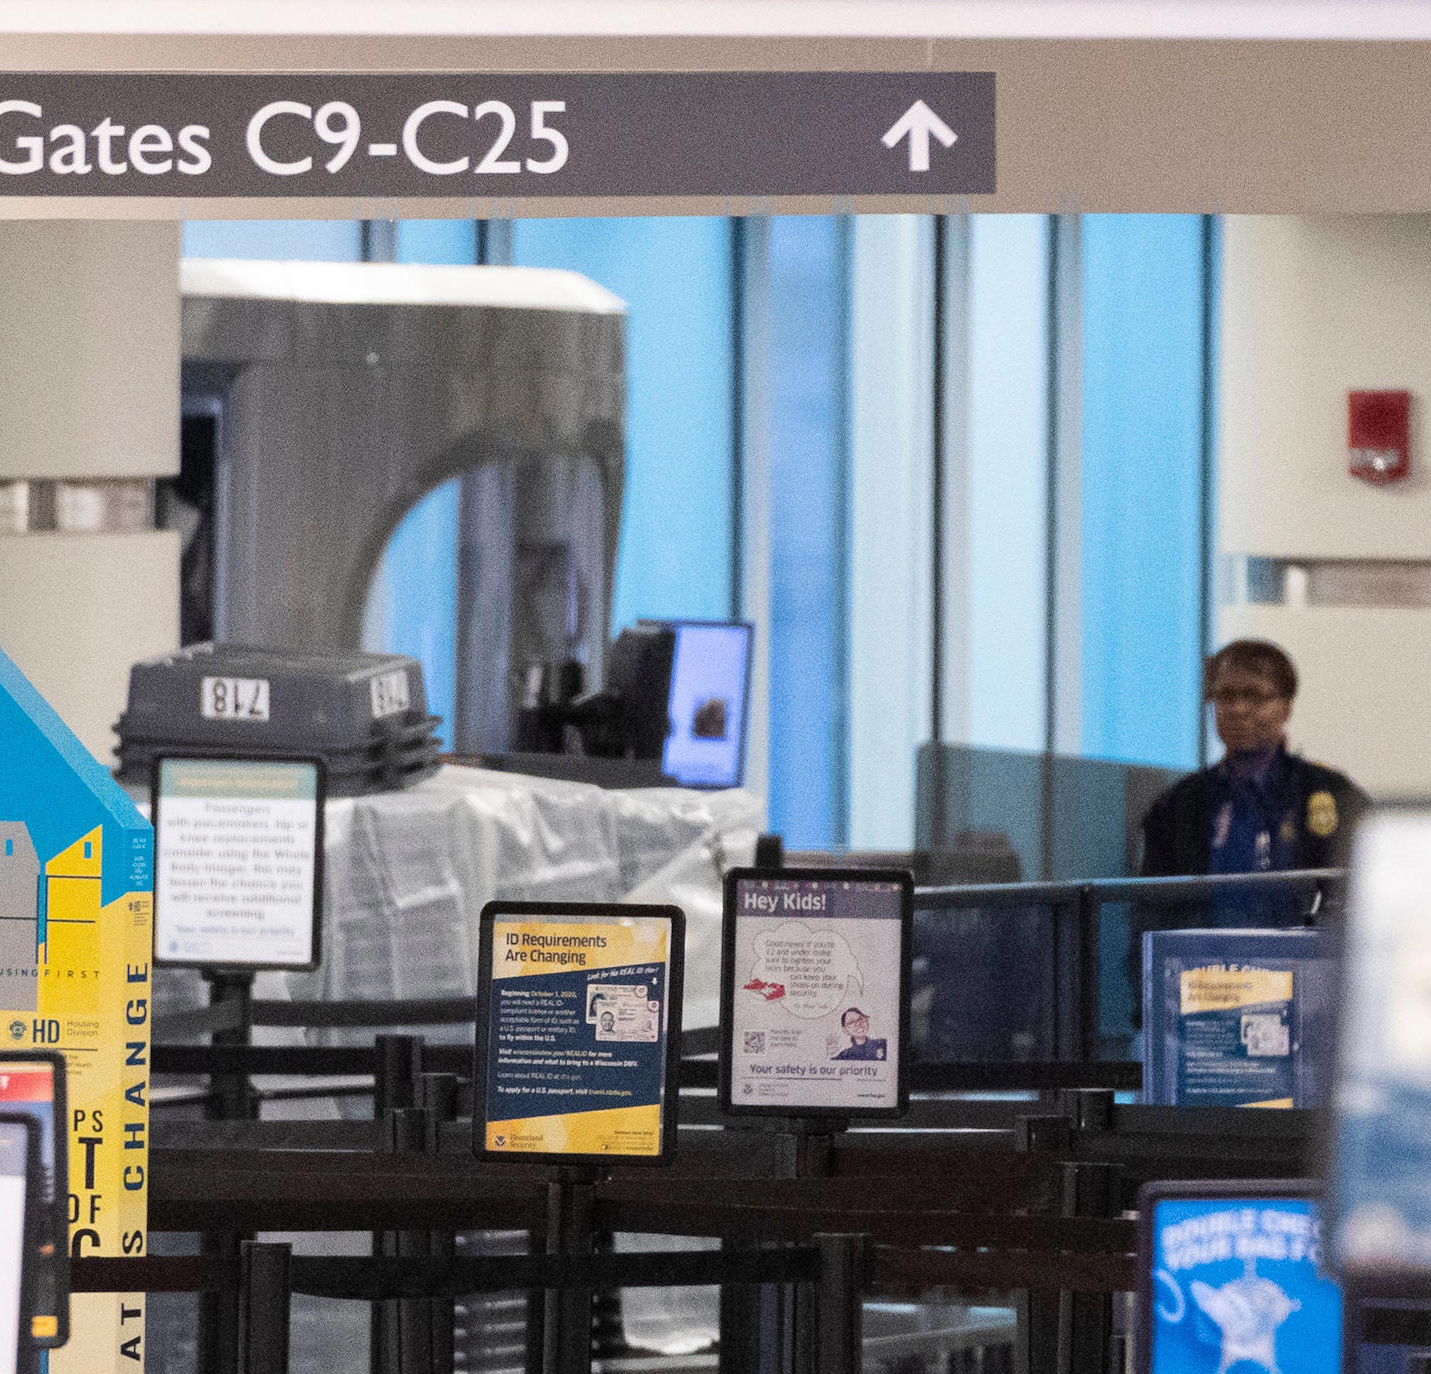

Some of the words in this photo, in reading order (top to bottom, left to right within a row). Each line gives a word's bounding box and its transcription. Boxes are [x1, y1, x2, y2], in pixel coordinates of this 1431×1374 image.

[246, 100, 568, 176] C9-C25
[213, 680, 263, 715] 718
[744, 893, 778, 913] Hey
[783, 893, 827, 911] Kids!
[506, 933, 519, 946] ID
[522, 933, 607, 949] Requirements
[505, 949, 527, 962] Are
[530, 950, 586, 967] Changing
[44, 967, 101, 979] FIRST
[33, 1018, 60, 1044] HD
[67, 1020, 100, 1030] Housing
[123, 962, 149, 1191] CHANGE
[750, 1064, 773, 1075] Your
[775, 1064, 806, 1076] safety
[809, 1064, 817, 1075] is
[820, 1066, 836, 1075] our
[839, 1065, 878, 1077] priority
